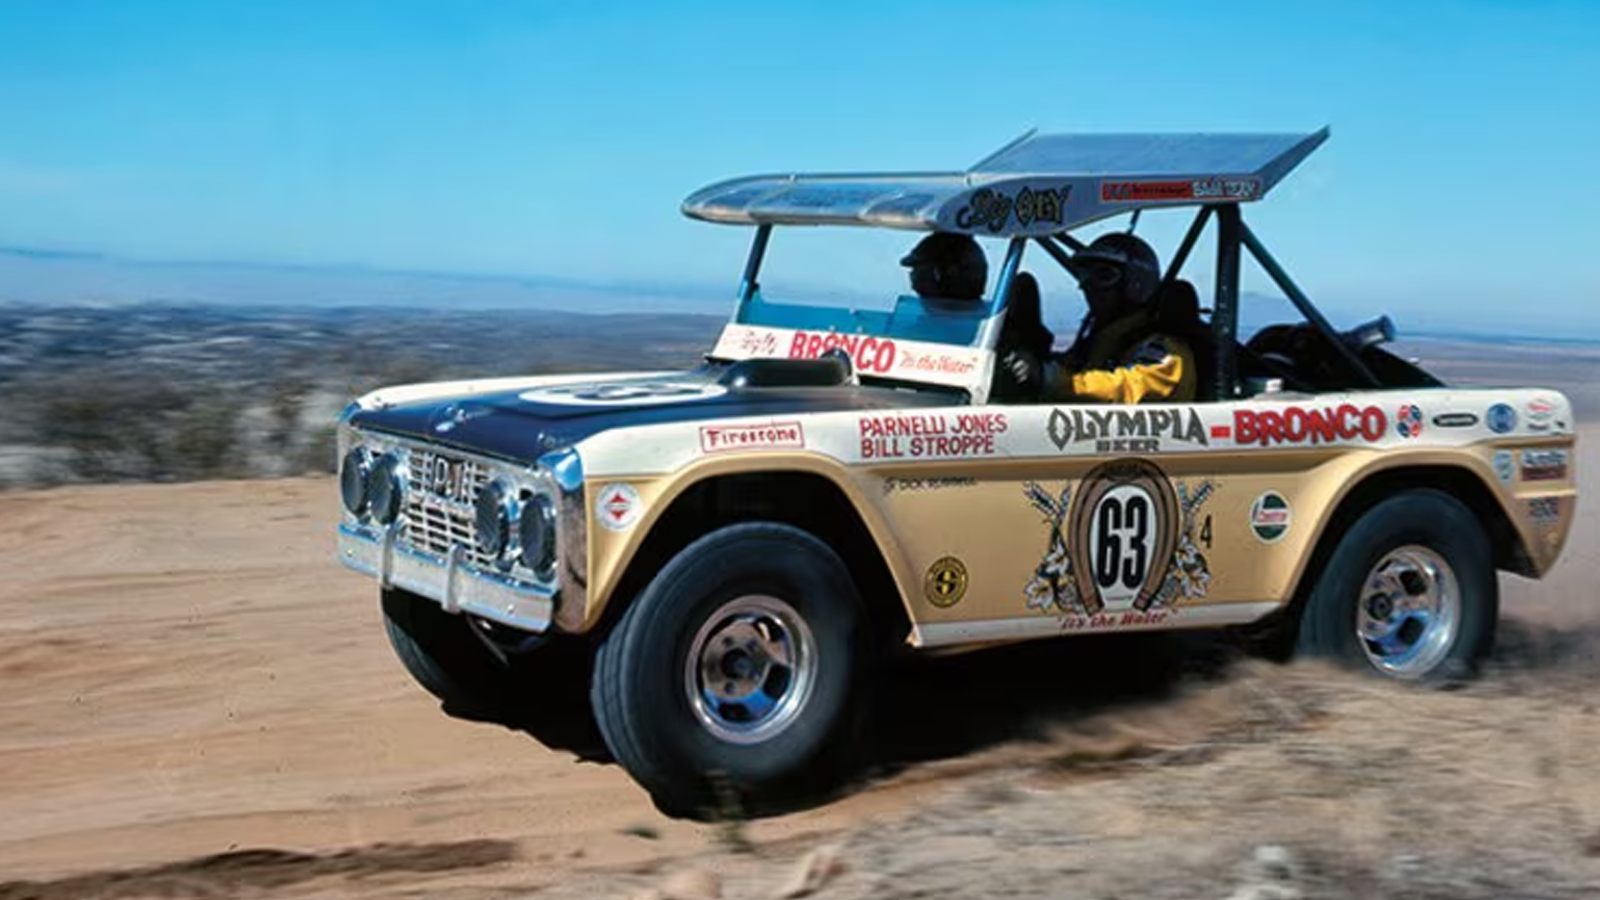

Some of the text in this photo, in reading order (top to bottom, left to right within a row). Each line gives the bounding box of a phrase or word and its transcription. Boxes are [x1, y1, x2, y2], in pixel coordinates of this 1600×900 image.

[787, 329, 896, 373] BRONCO
[706, 429, 797, 447] Firestone
[859, 414, 1008, 438] PARNELLI JONES
[1047, 407, 1209, 451] OLYMPIA
[1233, 404, 1388, 445] BRONCO
[861, 434, 994, 458] BILL STROPPE
[1095, 439, 1161, 452] BEER
[1098, 495, 1149, 589] 63
[1200, 514, 1212, 549] 4
